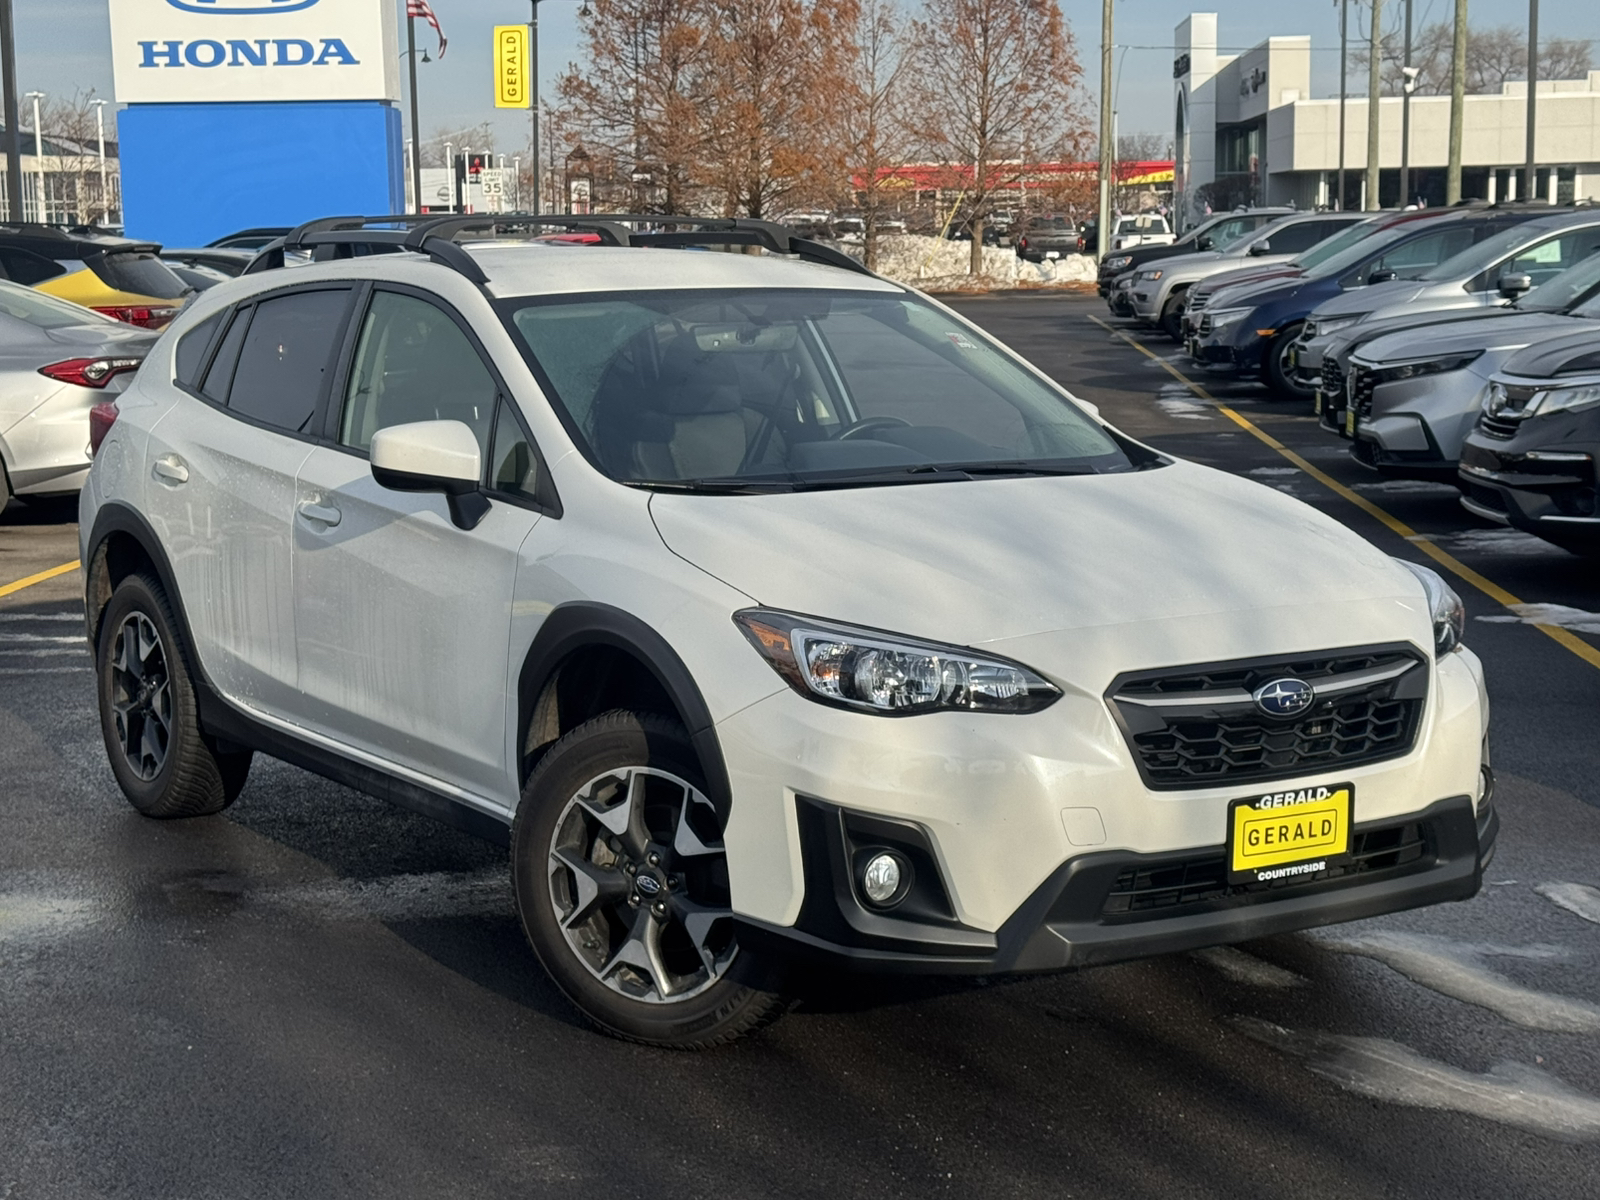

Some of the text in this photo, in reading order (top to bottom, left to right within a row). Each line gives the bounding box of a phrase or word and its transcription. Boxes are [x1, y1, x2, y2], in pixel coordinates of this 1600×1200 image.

[137, 38, 361, 68] HONDA
[506, 36, 517, 97] GERALD
[484, 182, 501, 193] 35
[1247, 819, 1332, 846] GERALD
[1257, 861, 1326, 881] COUNTRYSIDE
